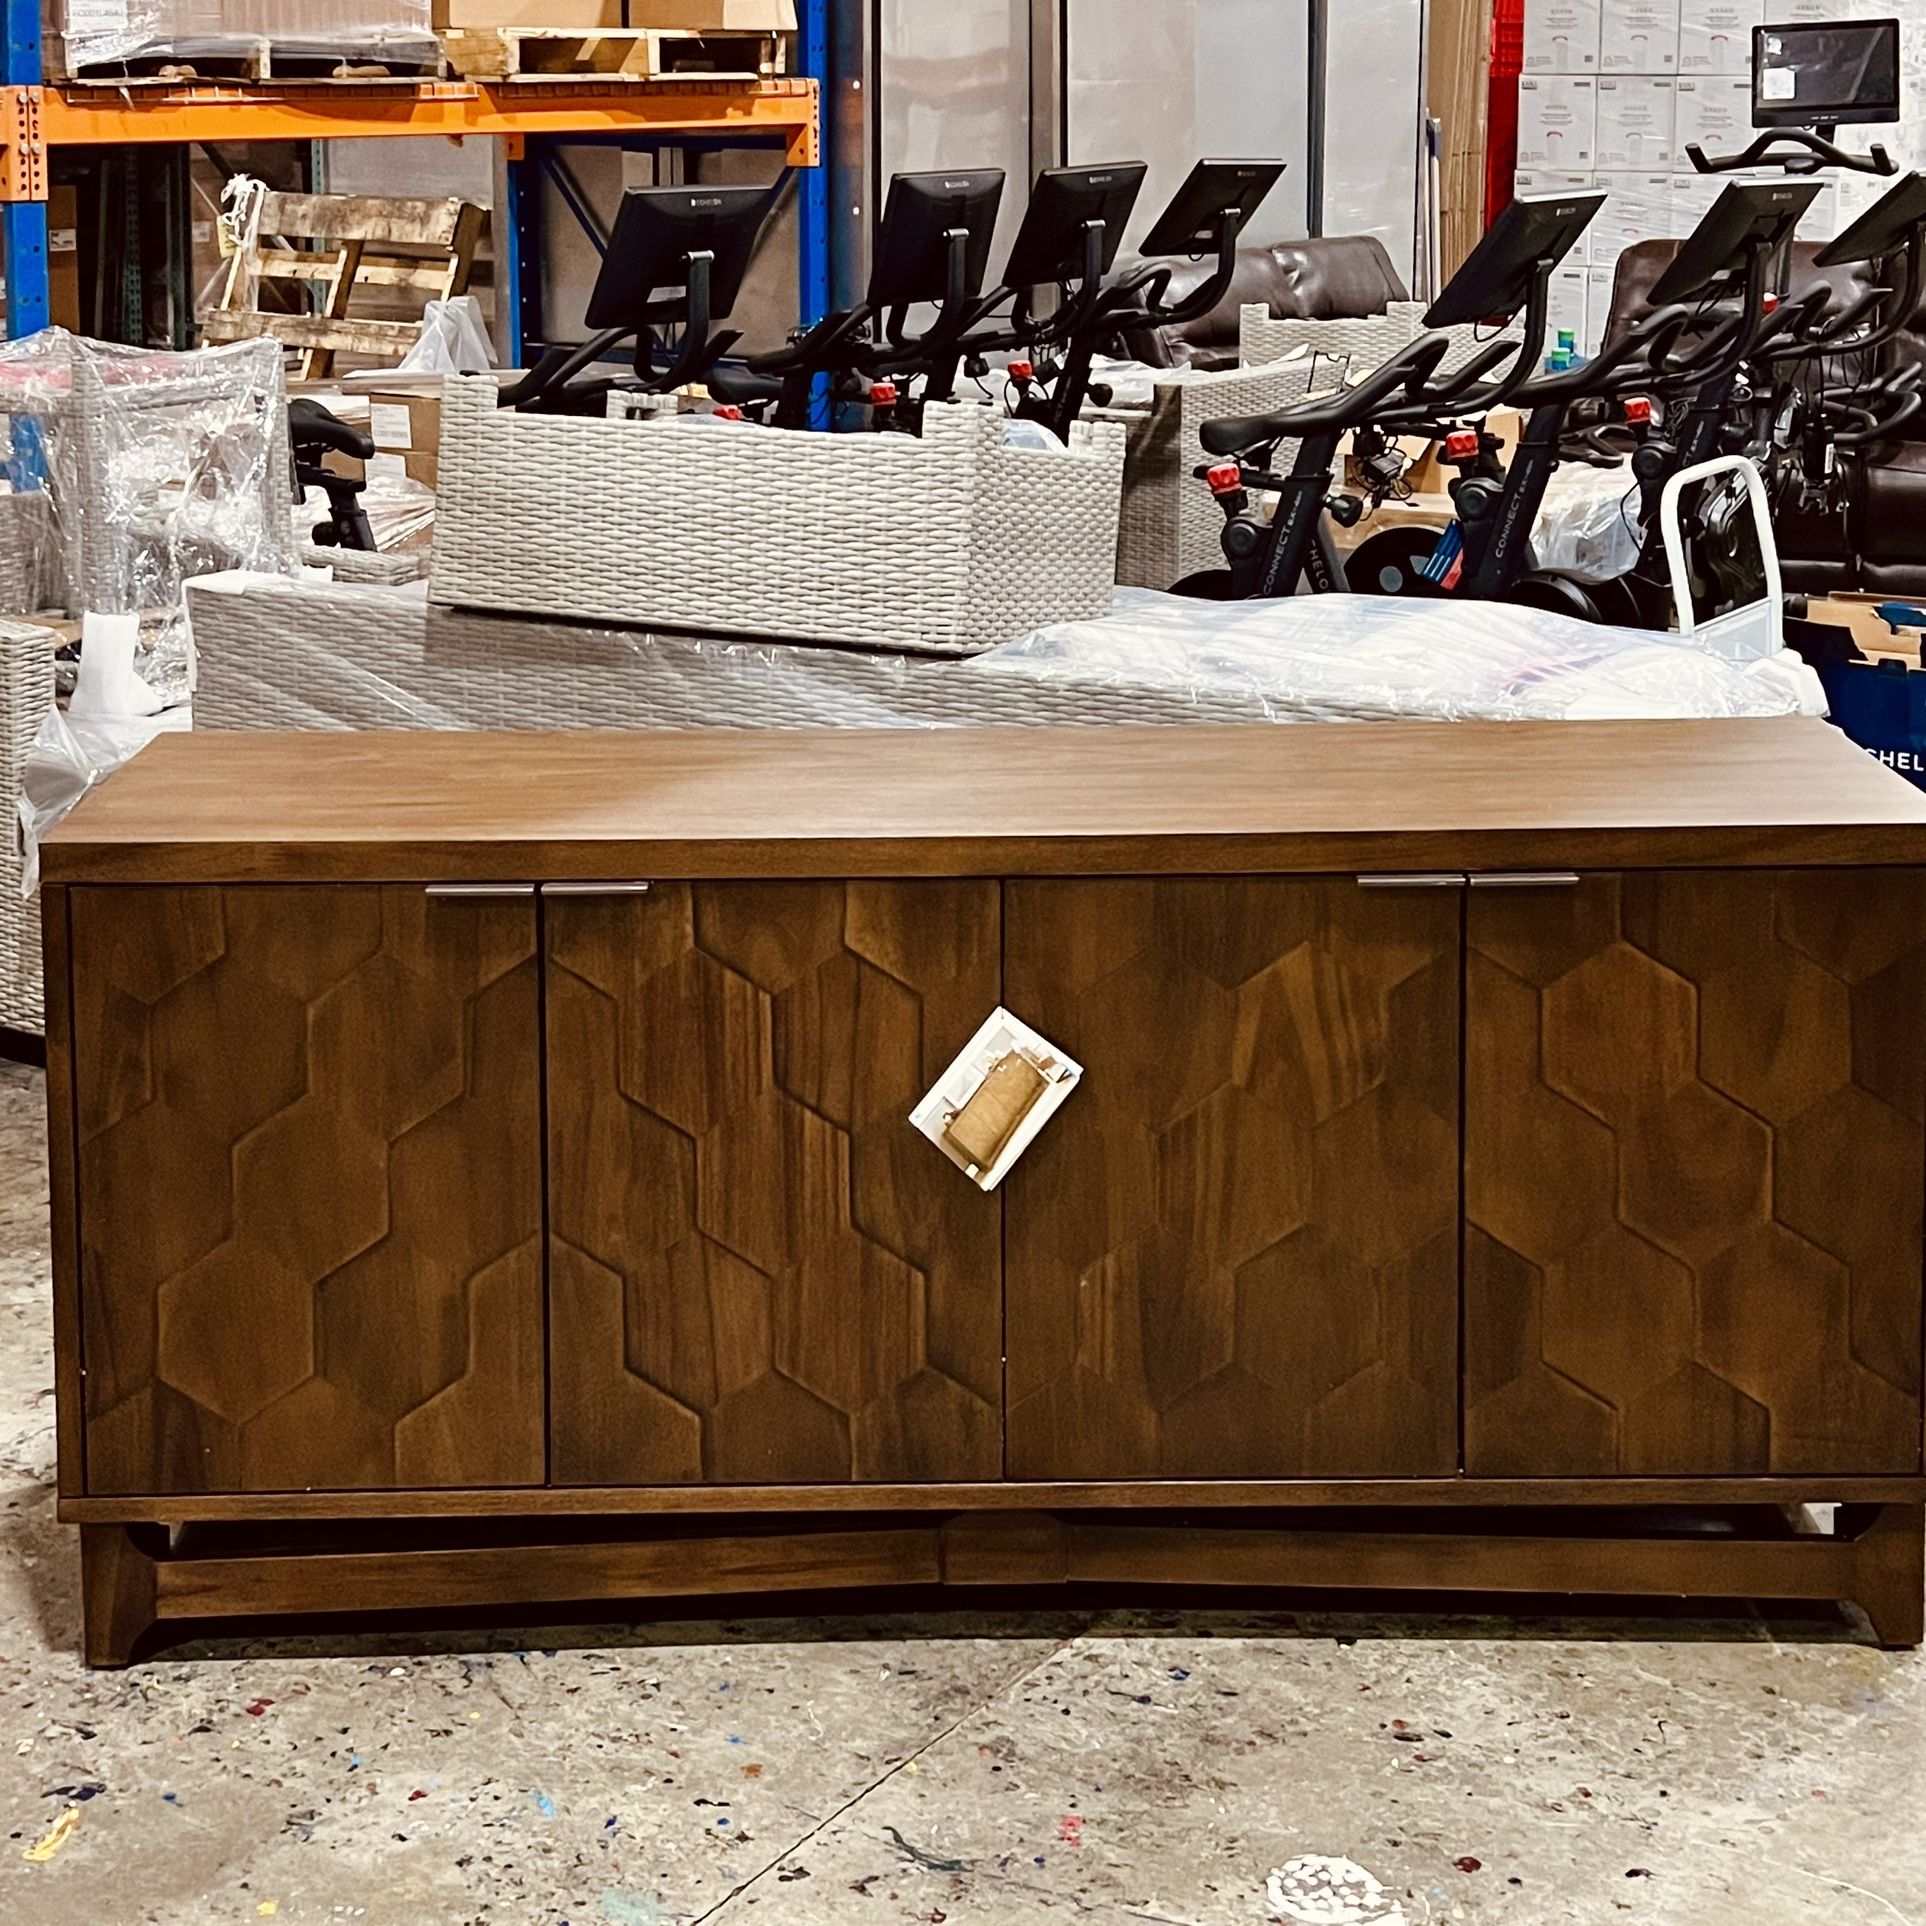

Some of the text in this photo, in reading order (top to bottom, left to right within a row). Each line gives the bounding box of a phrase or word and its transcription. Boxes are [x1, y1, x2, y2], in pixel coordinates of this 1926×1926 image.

[1495, 492, 1521, 558] CONNECT
[1263, 525, 1291, 595] CONNECT
[1311, 539, 1329, 590] HELO
